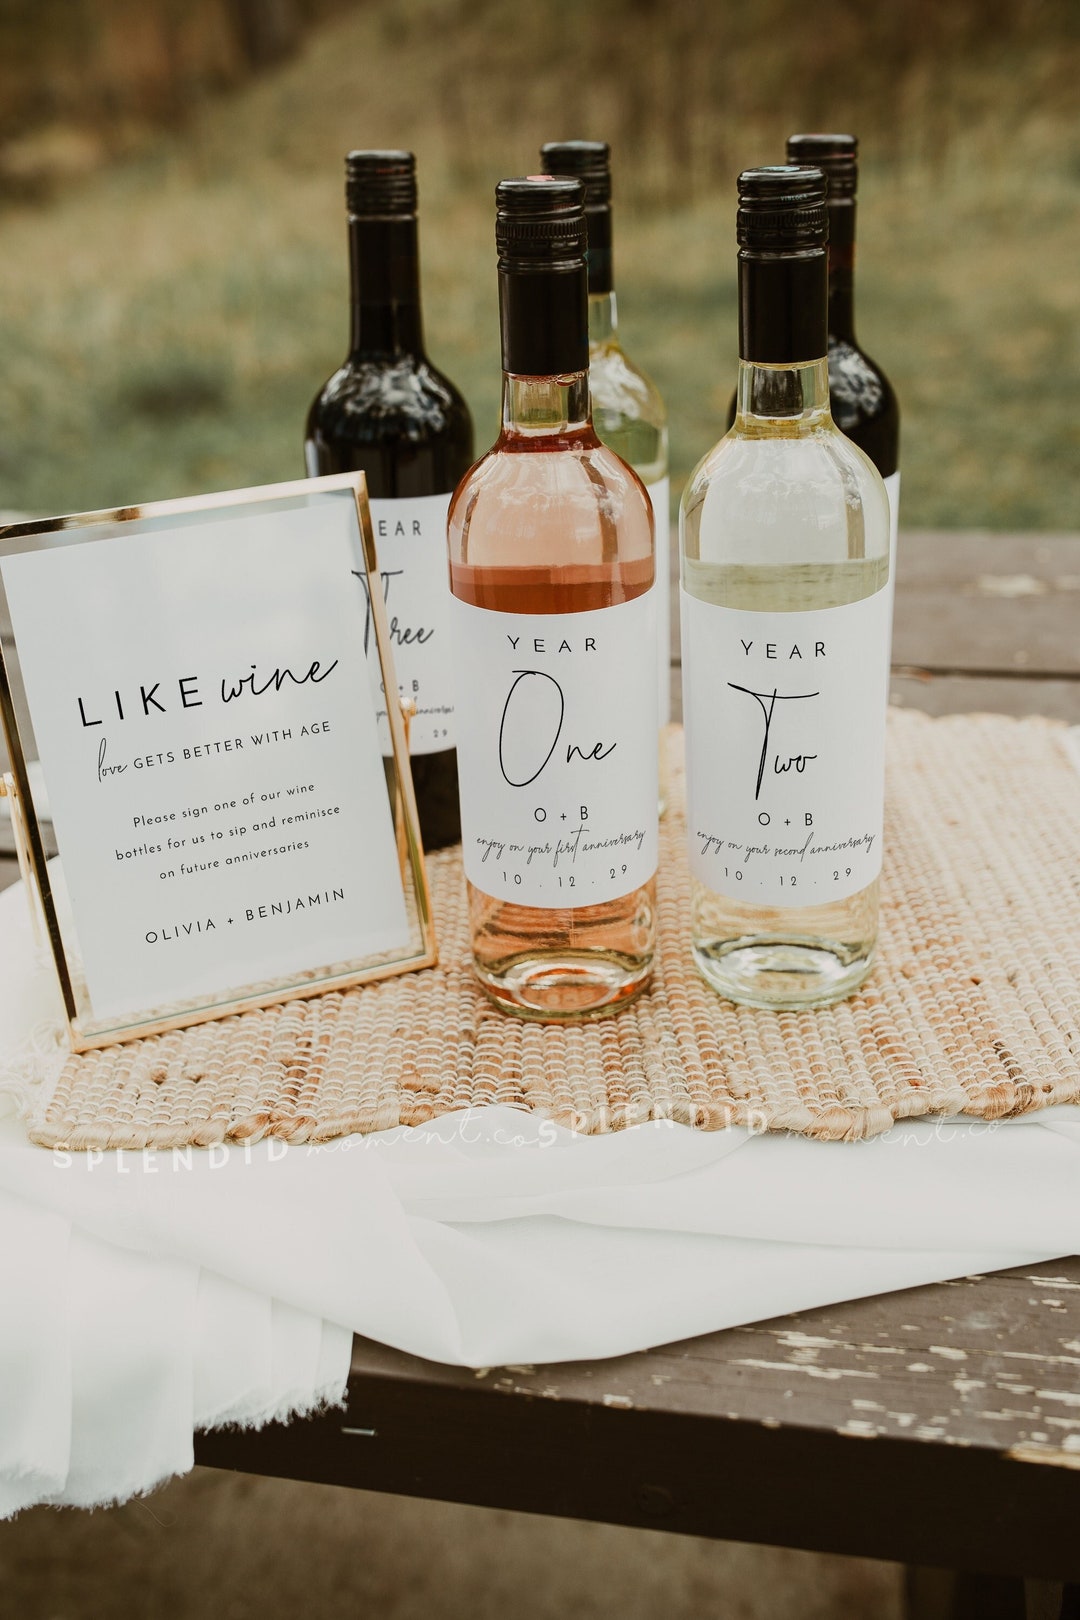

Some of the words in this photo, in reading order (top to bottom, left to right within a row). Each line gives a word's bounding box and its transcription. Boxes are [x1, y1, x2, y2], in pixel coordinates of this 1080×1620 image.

[377, 519, 422, 537] EAR
[506, 634, 597, 654] YEAR
[740, 639, 826, 660] YEAR
[77, 675, 203, 728] LIKE
[220, 659, 339, 704] wine
[412, 679, 419, 692] B
[498, 669, 617, 788] One
[726, 681, 820, 801] Two
[97, 737, 128, 783] love
[133, 751, 175, 769] GETS
[182, 738, 244, 760] BETTER
[250, 728, 292, 746] WITH
[300, 720, 331, 737] AGE
[133, 813, 176, 828] Please
[181, 806, 209, 818] sign
[213, 800, 237, 812] one
[242, 792, 255, 806] of
[260, 791, 281, 802] our
[286, 784, 315, 796] wine
[533, 807, 547, 823] O
[579, 805, 589, 821] B
[757, 811, 771, 827] O
[804, 812, 814, 827] B
[115, 843, 162, 861] bottles
[167, 837, 186, 850] for
[191, 835, 206, 845] us
[210, 831, 224, 841] to
[228, 826, 247, 837] sip
[252, 815, 277, 832] and
[281, 806, 340, 825] reminisce
[476, 837, 506, 863] enjoy
[509, 843, 524, 852] on
[527, 842, 552, 865] your
[553, 823, 590, 868] first
[582, 830, 646, 850] anniversary
[697, 831, 725, 855] enjoy
[727, 842, 743, 850] on
[744, 844, 770, 863] your
[774, 831, 814, 863] second
[809, 833, 876, 854] anniversary
[159, 870, 175, 880] on
[180, 860, 220, 875] future
[225, 840, 310, 865] anniversaries
[145, 918, 216, 944] OLIVIA
[245, 888, 345, 922] BENJAMIN
